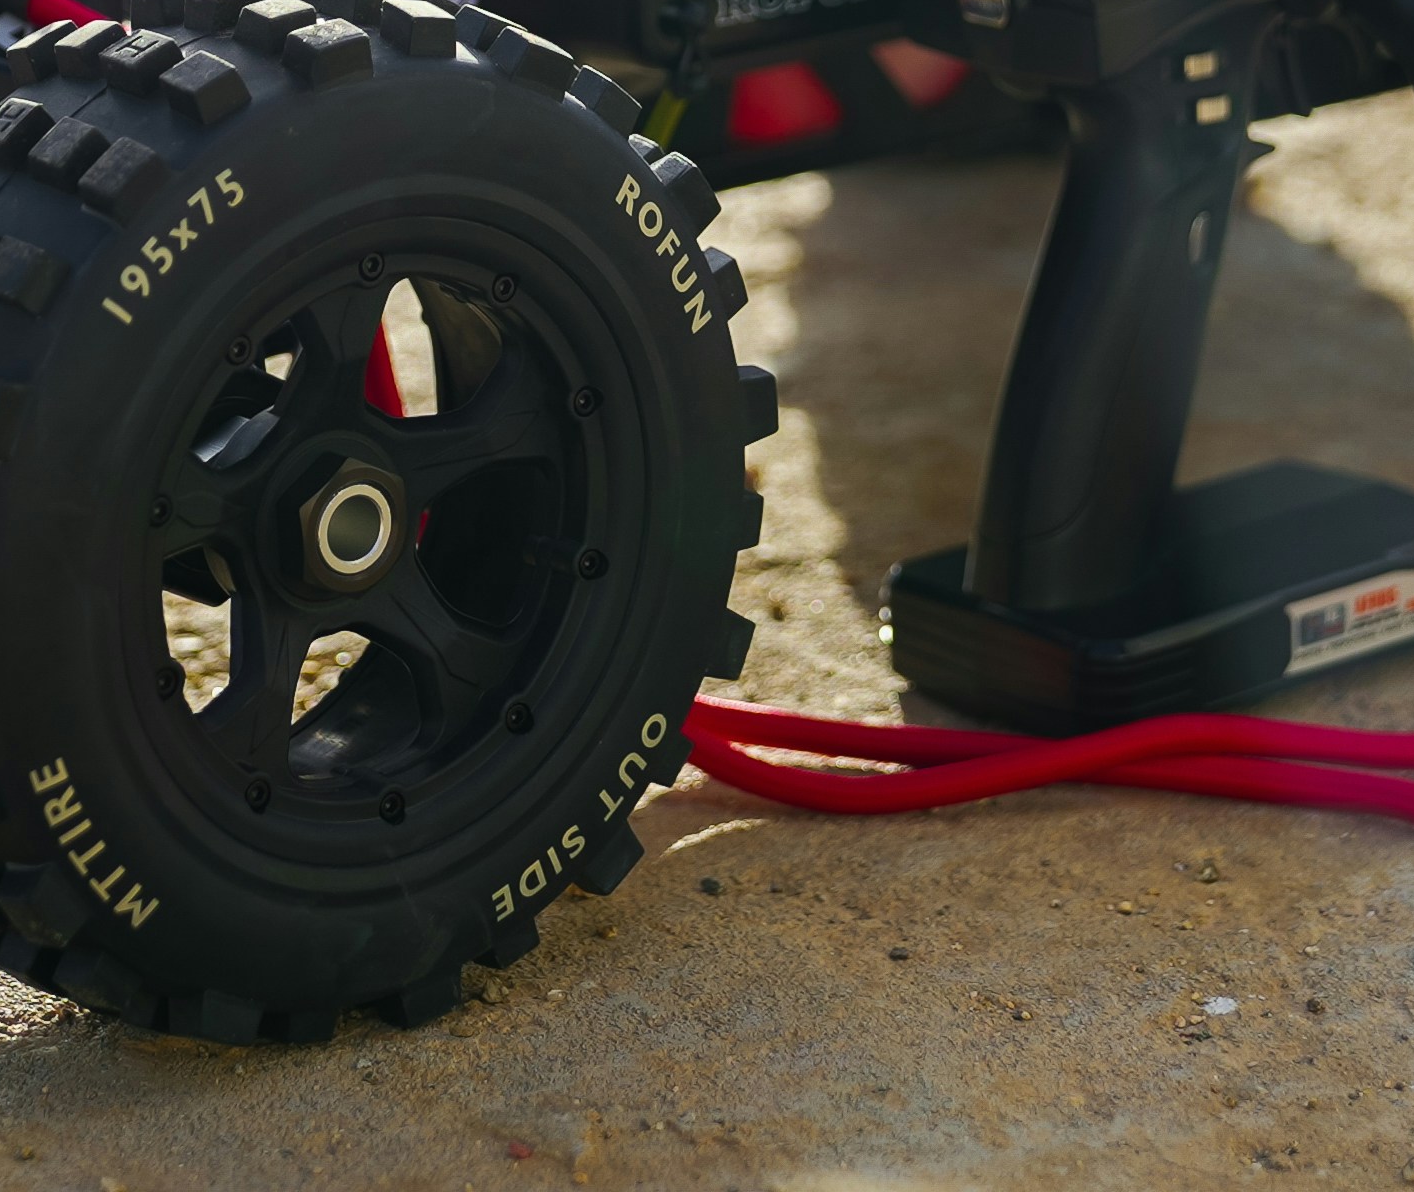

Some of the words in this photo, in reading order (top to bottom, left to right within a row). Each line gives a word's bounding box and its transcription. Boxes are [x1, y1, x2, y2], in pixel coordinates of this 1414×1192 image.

[101, 168, 246, 325] 195x75
[615, 174, 713, 335] ROFUN
[29, 757, 160, 928] MTTIRE
[599, 712, 668, 821] OUT
[491, 824, 587, 921] SIDE
